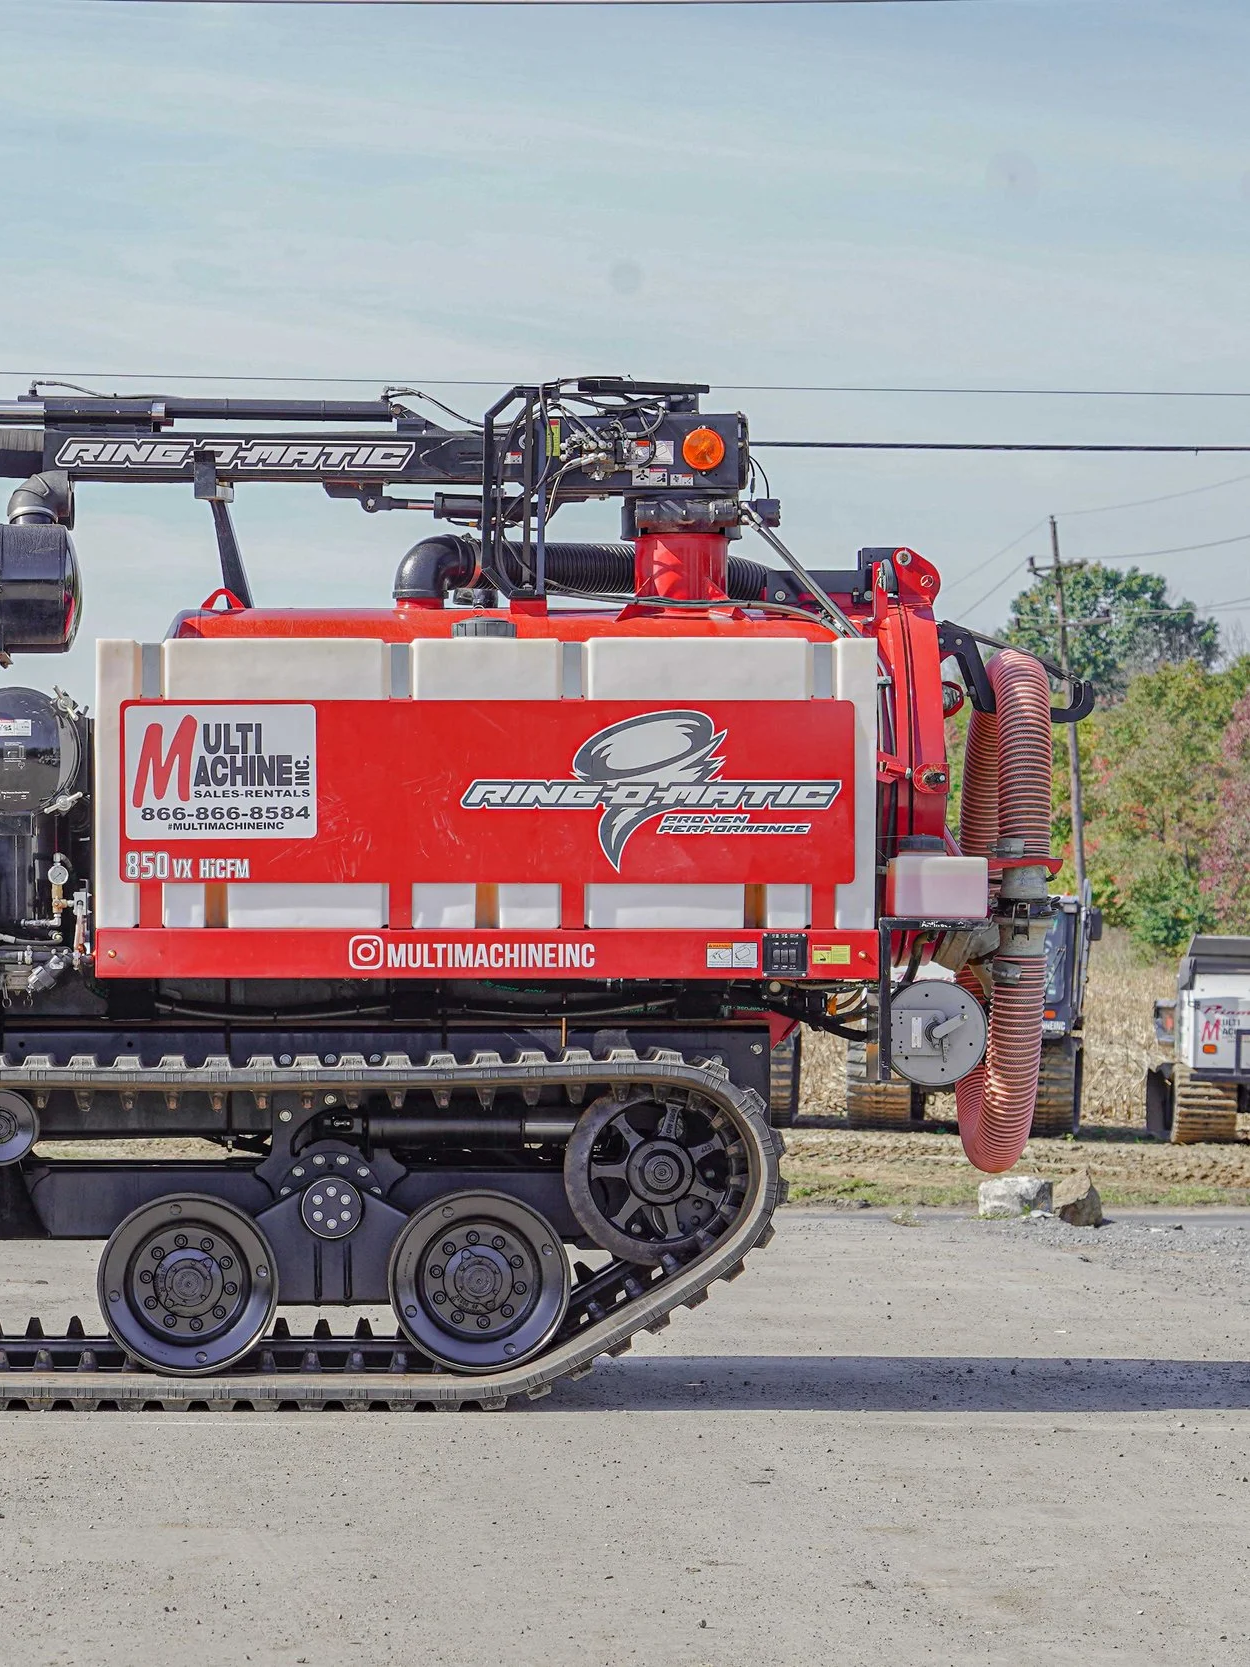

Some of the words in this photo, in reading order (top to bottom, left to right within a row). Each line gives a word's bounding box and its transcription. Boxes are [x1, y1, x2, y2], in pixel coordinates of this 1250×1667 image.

[295, 755, 310, 786] INC.
[194, 789, 310, 798] SALES-RENTALS
[462, 781, 840, 808] RING-O-MATIC
[141, 806, 310, 821] 866-866-8584
[662, 815, 749, 825] PROVEN
[167, 822, 284, 831] #MULTIMACHINEINC
[658, 825, 810, 833] PERFORMANCE
[125, 851, 170, 880] 850
[171, 858, 193, 879] VX
[387, 943, 596, 967] MULTIMACHINEINC
